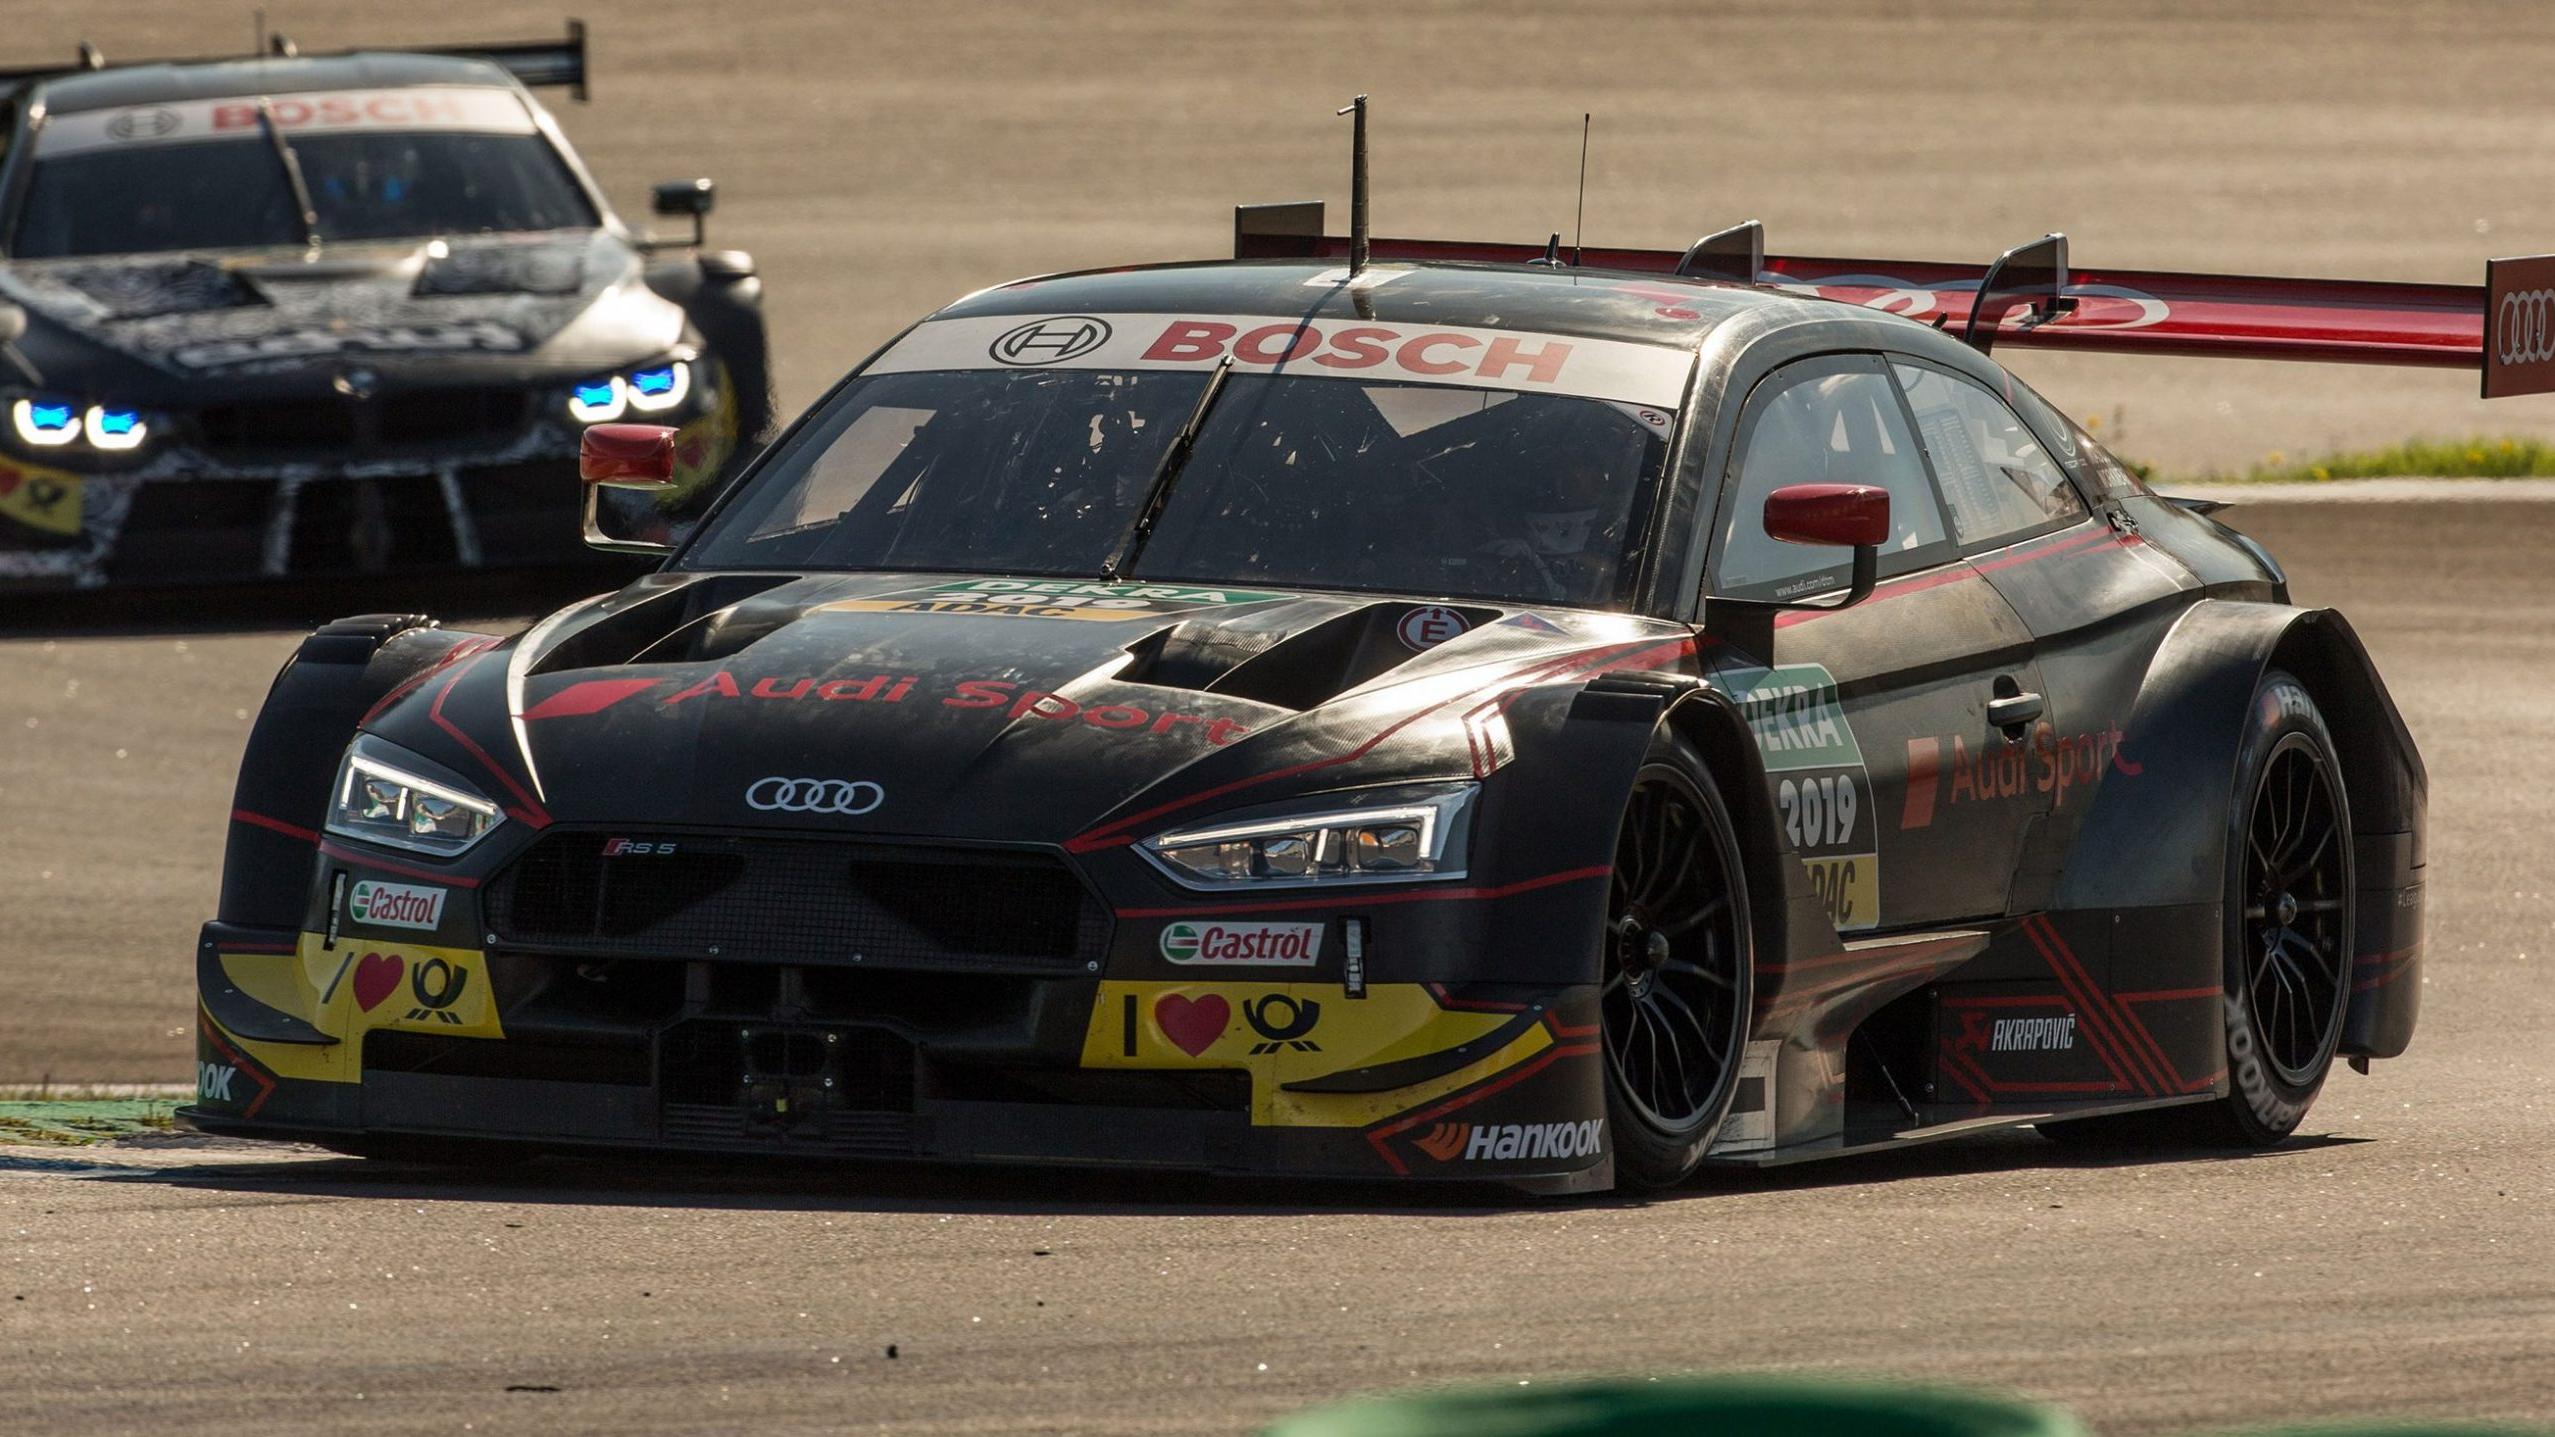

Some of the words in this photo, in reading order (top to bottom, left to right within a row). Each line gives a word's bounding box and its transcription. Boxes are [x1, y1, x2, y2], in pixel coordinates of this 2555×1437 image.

[213, 97, 464, 131] BOSCH
[1139, 320, 1573, 383] BOSCH
[893, 602, 1076, 617] ADAC
[926, 591, 1152, 609] 2019
[966, 580, 1231, 603] DEKRA
[664, 671, 919, 704] Audi
[942, 679, 1251, 746] Sport
[1950, 735, 2027, 805] Audi
[2034, 720, 2144, 807] Sport
[1779, 774, 1857, 848] 2019
[656, 843, 677, 855] 5
[369, 886, 438, 924] Castrol
[1200, 926, 1313, 960] Castrol
[1123, 995, 1137, 1056] I
